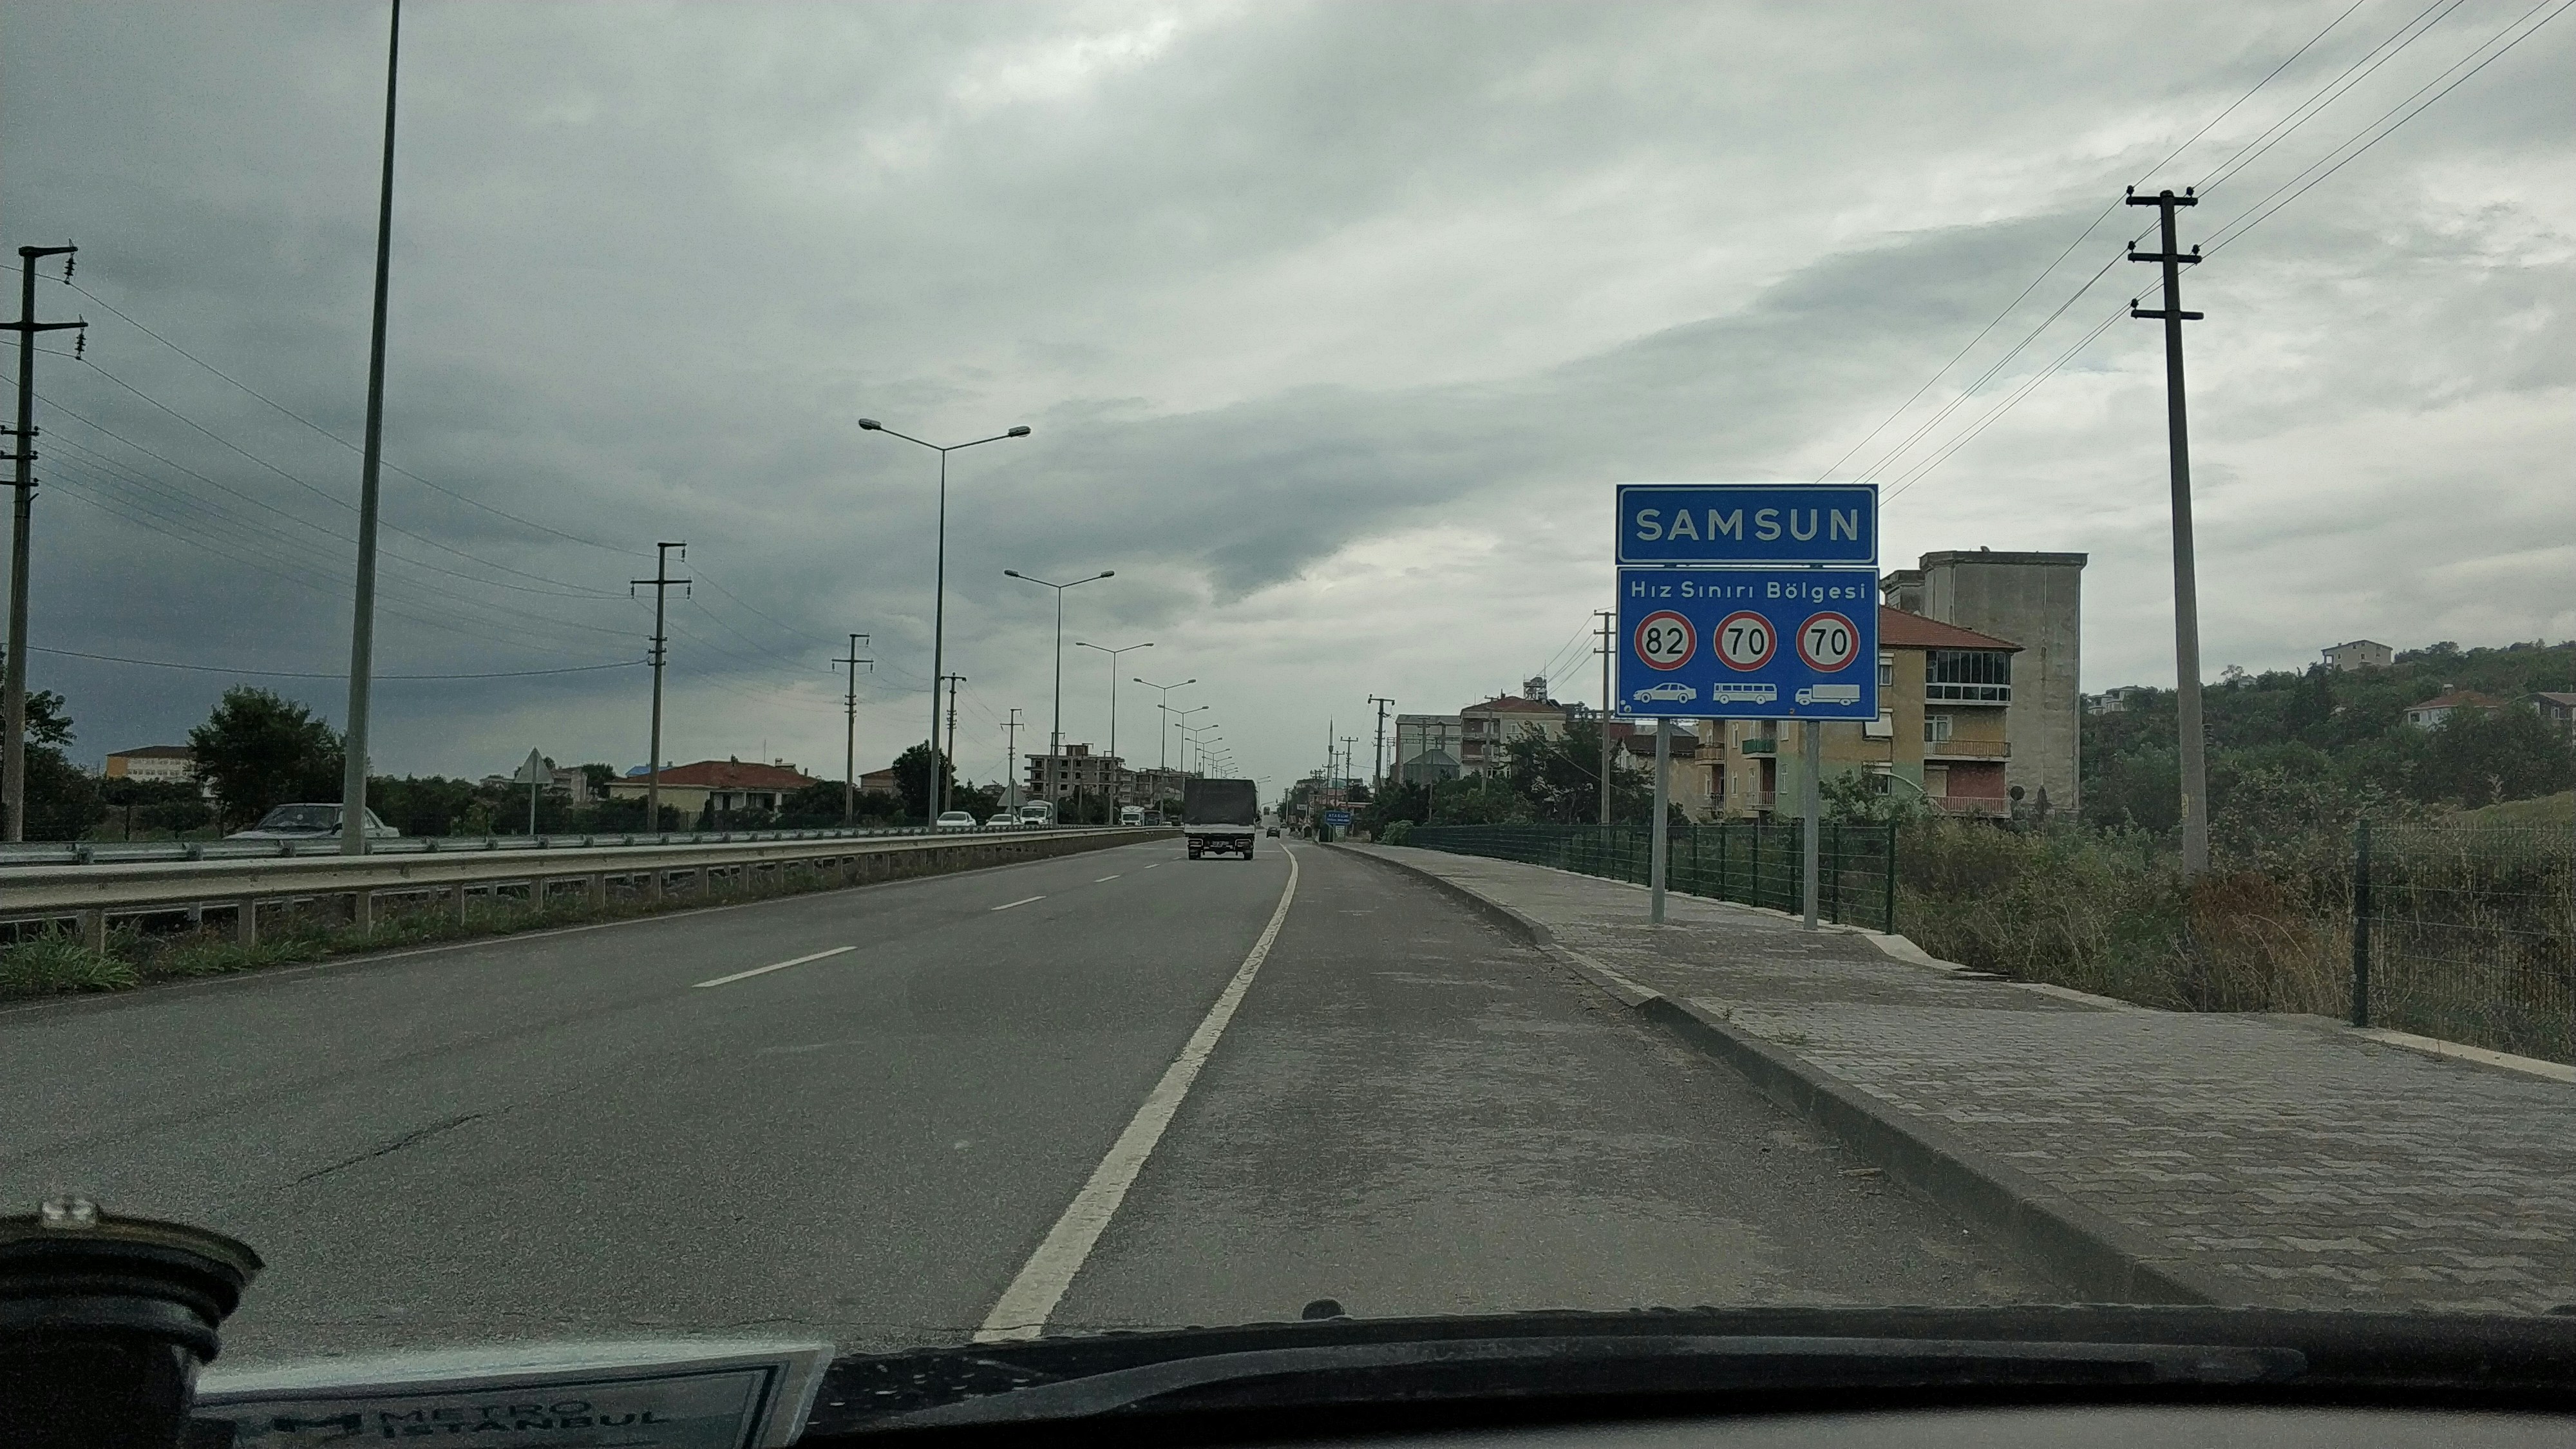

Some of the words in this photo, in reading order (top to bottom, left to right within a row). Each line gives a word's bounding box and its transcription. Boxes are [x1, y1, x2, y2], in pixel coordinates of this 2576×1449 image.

[1636, 509, 1858, 541] SAMSUN
[1631, 581, 1672, 598] Hız
[1681, 581, 1753, 598] Sınırı
[1767, 582, 1866, 603] Bölgesi
[1645, 627, 1683, 654] 82
[1728, 628, 1765, 655] 70
[1810, 629, 1847, 656] 70
